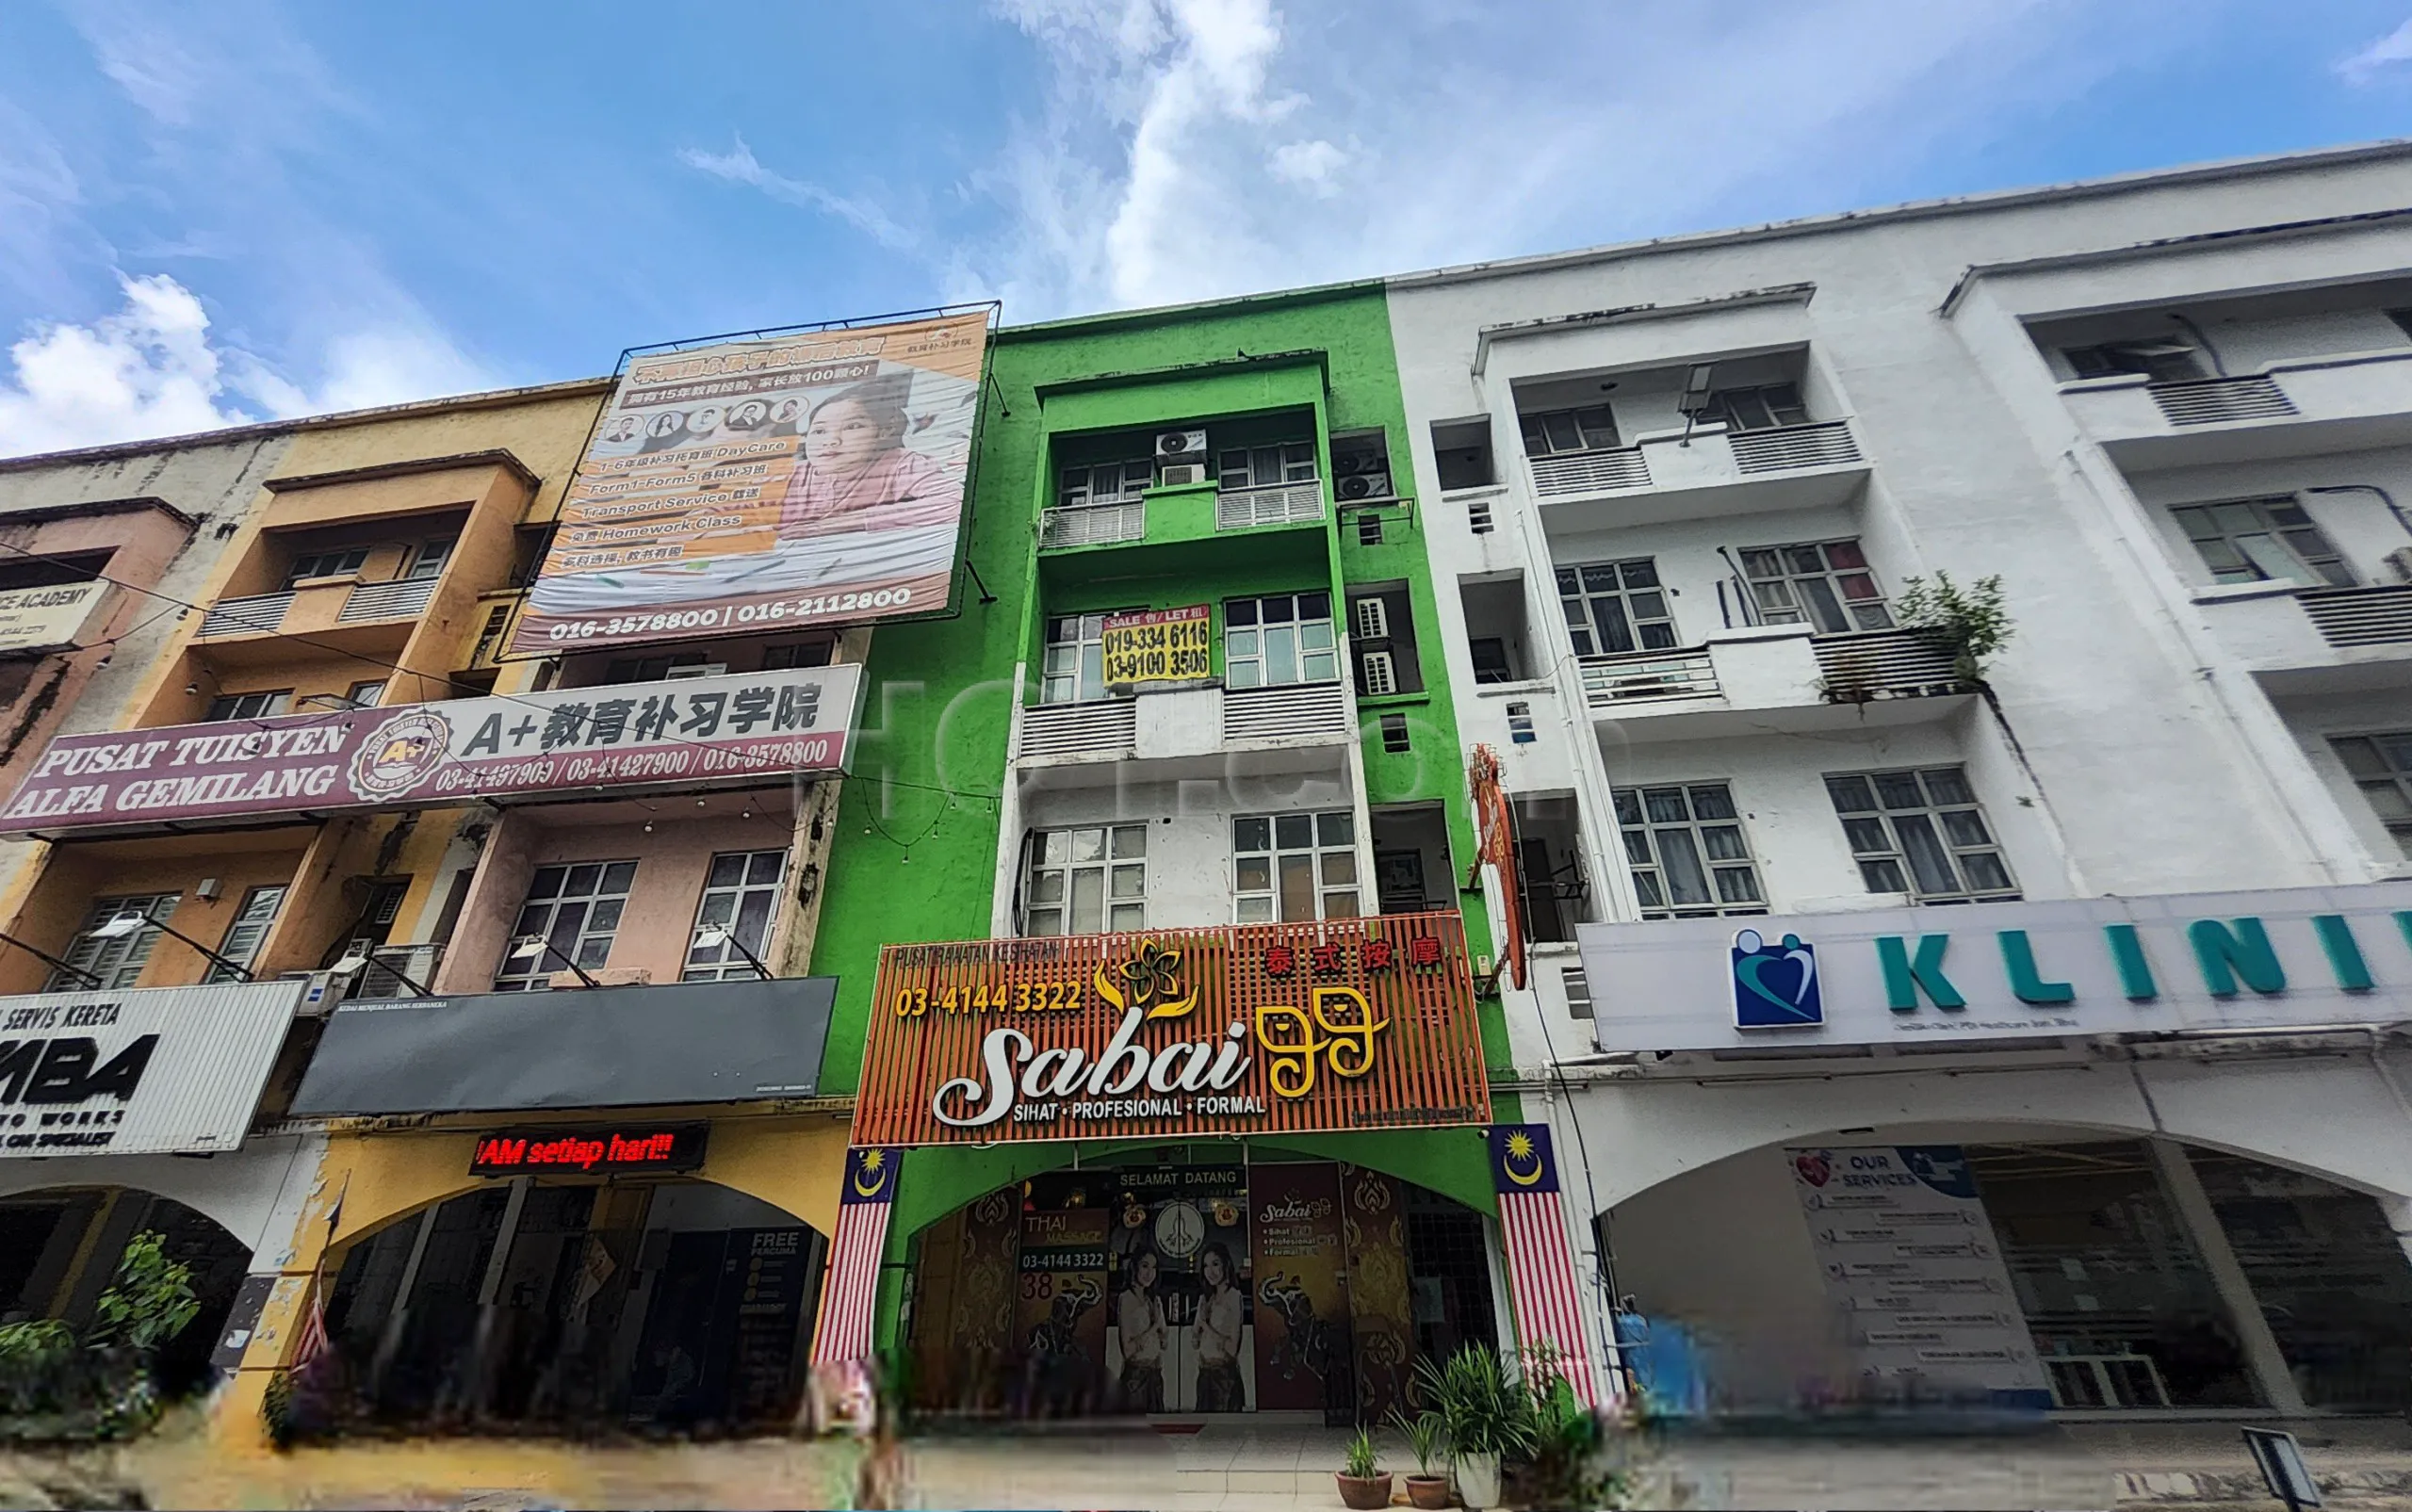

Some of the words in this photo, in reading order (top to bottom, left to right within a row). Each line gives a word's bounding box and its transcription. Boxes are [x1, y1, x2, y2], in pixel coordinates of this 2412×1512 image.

[589, 475, 695, 495] Form1-Form5
[581, 500, 660, 517] Transport
[664, 494, 727, 510] Service
[602, 521, 691, 540] Homework
[695, 515, 742, 529] Class
[14, 587, 93, 610] ACADEMY
[549, 609, 718, 641] 016-3578800
[738, 588, 912, 623] 016-2112800
[1110, 615, 1140, 627] SALE
[1165, 609, 1188, 620] LET
[1169, 621, 1207, 648] 6116
[1106, 650, 1165, 682] 03-9100
[1170, 648, 1207, 675] 3506
[34, 740, 166, 778] PUSAT
[170, 724, 355, 769] TUISYEN
[2, 785, 109, 820] ALFA
[115, 765, 336, 811] GEMILANG
[1265, 937, 1440, 976] 泰式按摩
[895, 985, 1008, 1017] 03-4144
[1015, 980, 1082, 1012] 3322
[3, 1006, 61, 1032] SERVIS
[61, 1002, 122, 1028] KERETA
[932, 1006, 1252, 1127] Sabai
[1013, 1102, 1061, 1123] SIHAT
[1071, 1098, 1182, 1119] PROFESIONAL
[1197, 1096, 1266, 1115] FORMAL
[528, 1137, 606, 1170] setiap
[1850, 1156, 1888, 1169] OUR
[1119, 1173, 1179, 1186] SELAMAT
[1185, 1171, 1236, 1183] DATANG
[1843, 1173, 1916, 1187] SERVICES
[1025, 1215, 1067, 1232] THAI
[1260, 1201, 1311, 1223] Sabai
[753, 1232, 798, 1247] FREE
[1022, 1254, 1071, 1268] 03-4144
[1074, 1253, 1103, 1266] 3322
[1021, 1274, 1052, 1299] 38
